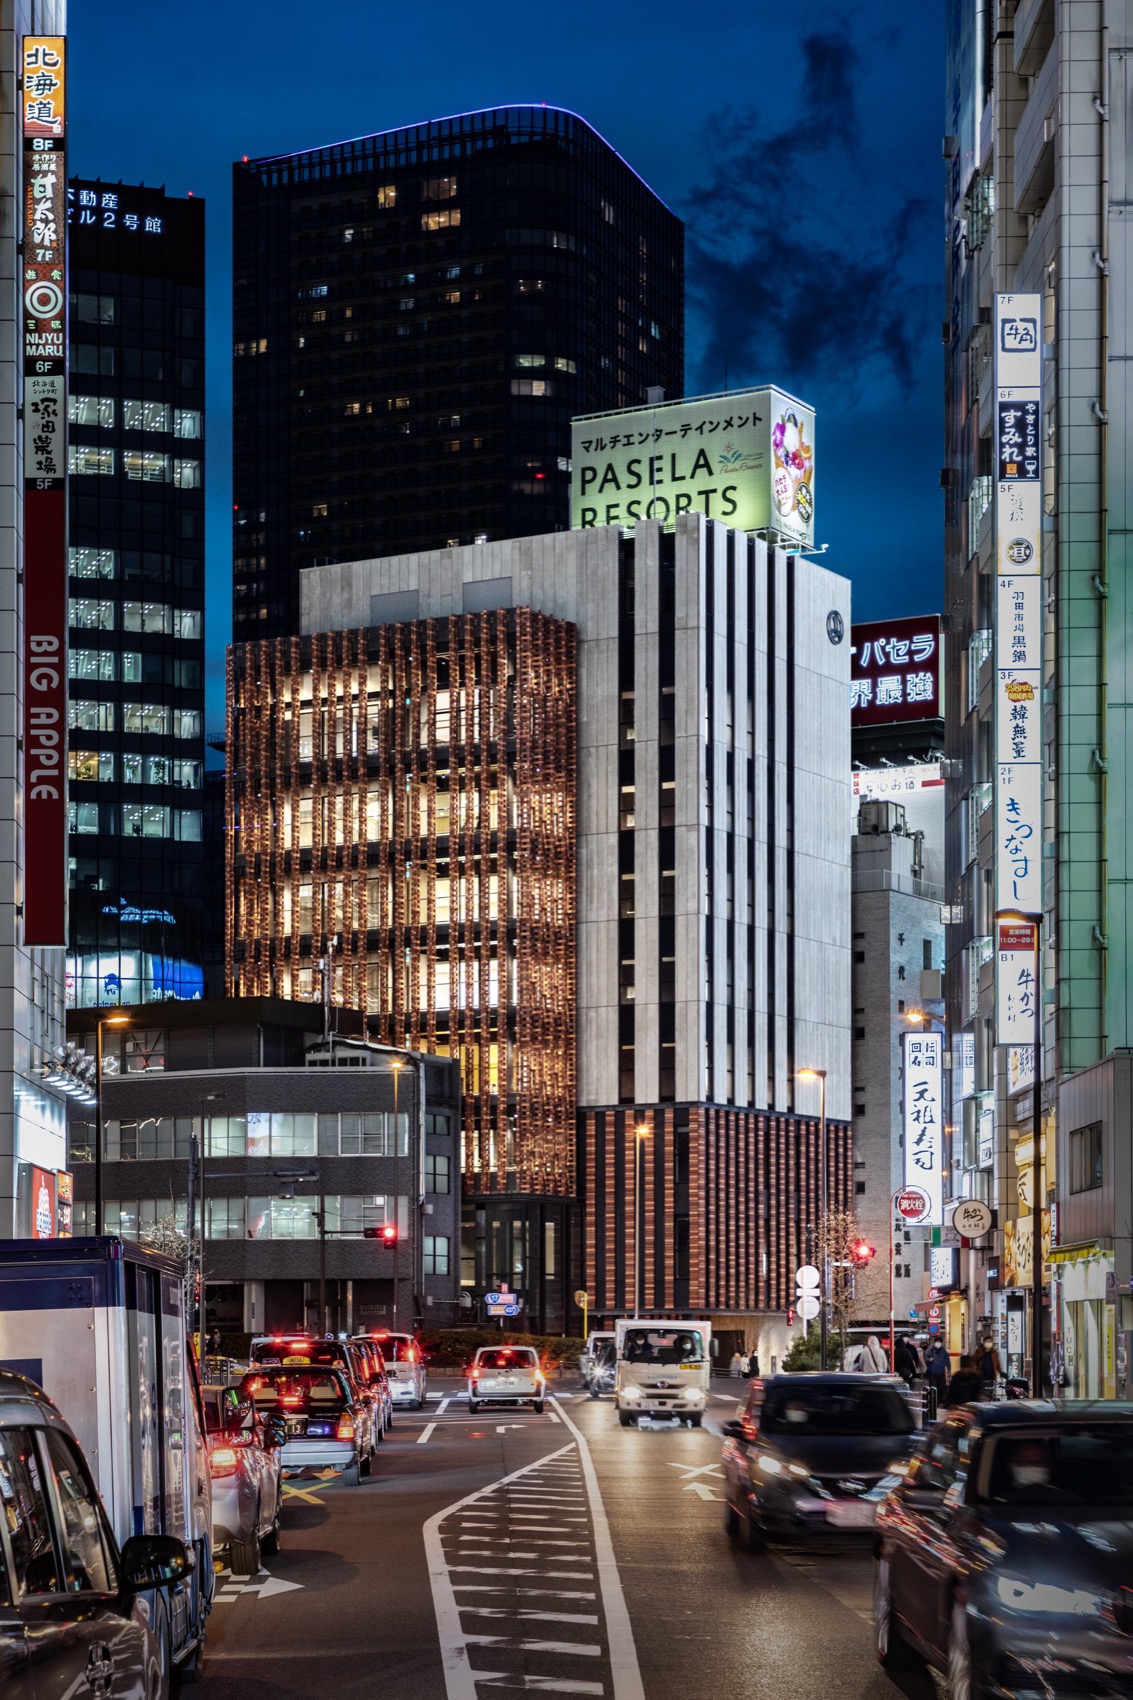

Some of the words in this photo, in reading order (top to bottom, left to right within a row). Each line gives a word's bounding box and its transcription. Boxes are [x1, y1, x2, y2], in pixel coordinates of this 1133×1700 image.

[26, 47, 60, 125] 北海道
[32, 138, 54, 151] 8F
[31, 172, 57, 247] 甘太郎
[36, 250, 54, 261] 7F
[1000, 296, 1014, 305] 7F
[26, 333, 63, 344] NIJYU
[1006, 324, 1034, 345] 牛角
[35, 361, 53, 373] 6F
[32, 380, 57, 388] 北海道
[1000, 391, 1014, 399] 6F
[31, 397, 58, 475] 塚田農場
[1001, 409, 1023, 462] すみれ
[1025, 403, 1037, 457] やきとり家
[580, 447, 714, 497] PASELA
[36, 479, 53, 490] 5F
[1000, 485, 1014, 493] 5F
[1000, 580, 1014, 588] 4F
[850, 634, 936, 667] パセラ
[29, 635, 60, 692] BIG
[1000, 671, 1014, 680] 3F
[29, 707, 60, 800] APPLE
[1000, 767, 1014, 775] 2F
[1001, 777, 1014, 785] 1F
[1001, 954, 1015, 962] B1
[1017, 968, 1035, 1018] 牛かつ
[911, 1042, 936, 1053] 回転
[910, 1081, 937, 1171] 元祖寿司
[900, 1198, 924, 1211] 消火栓
